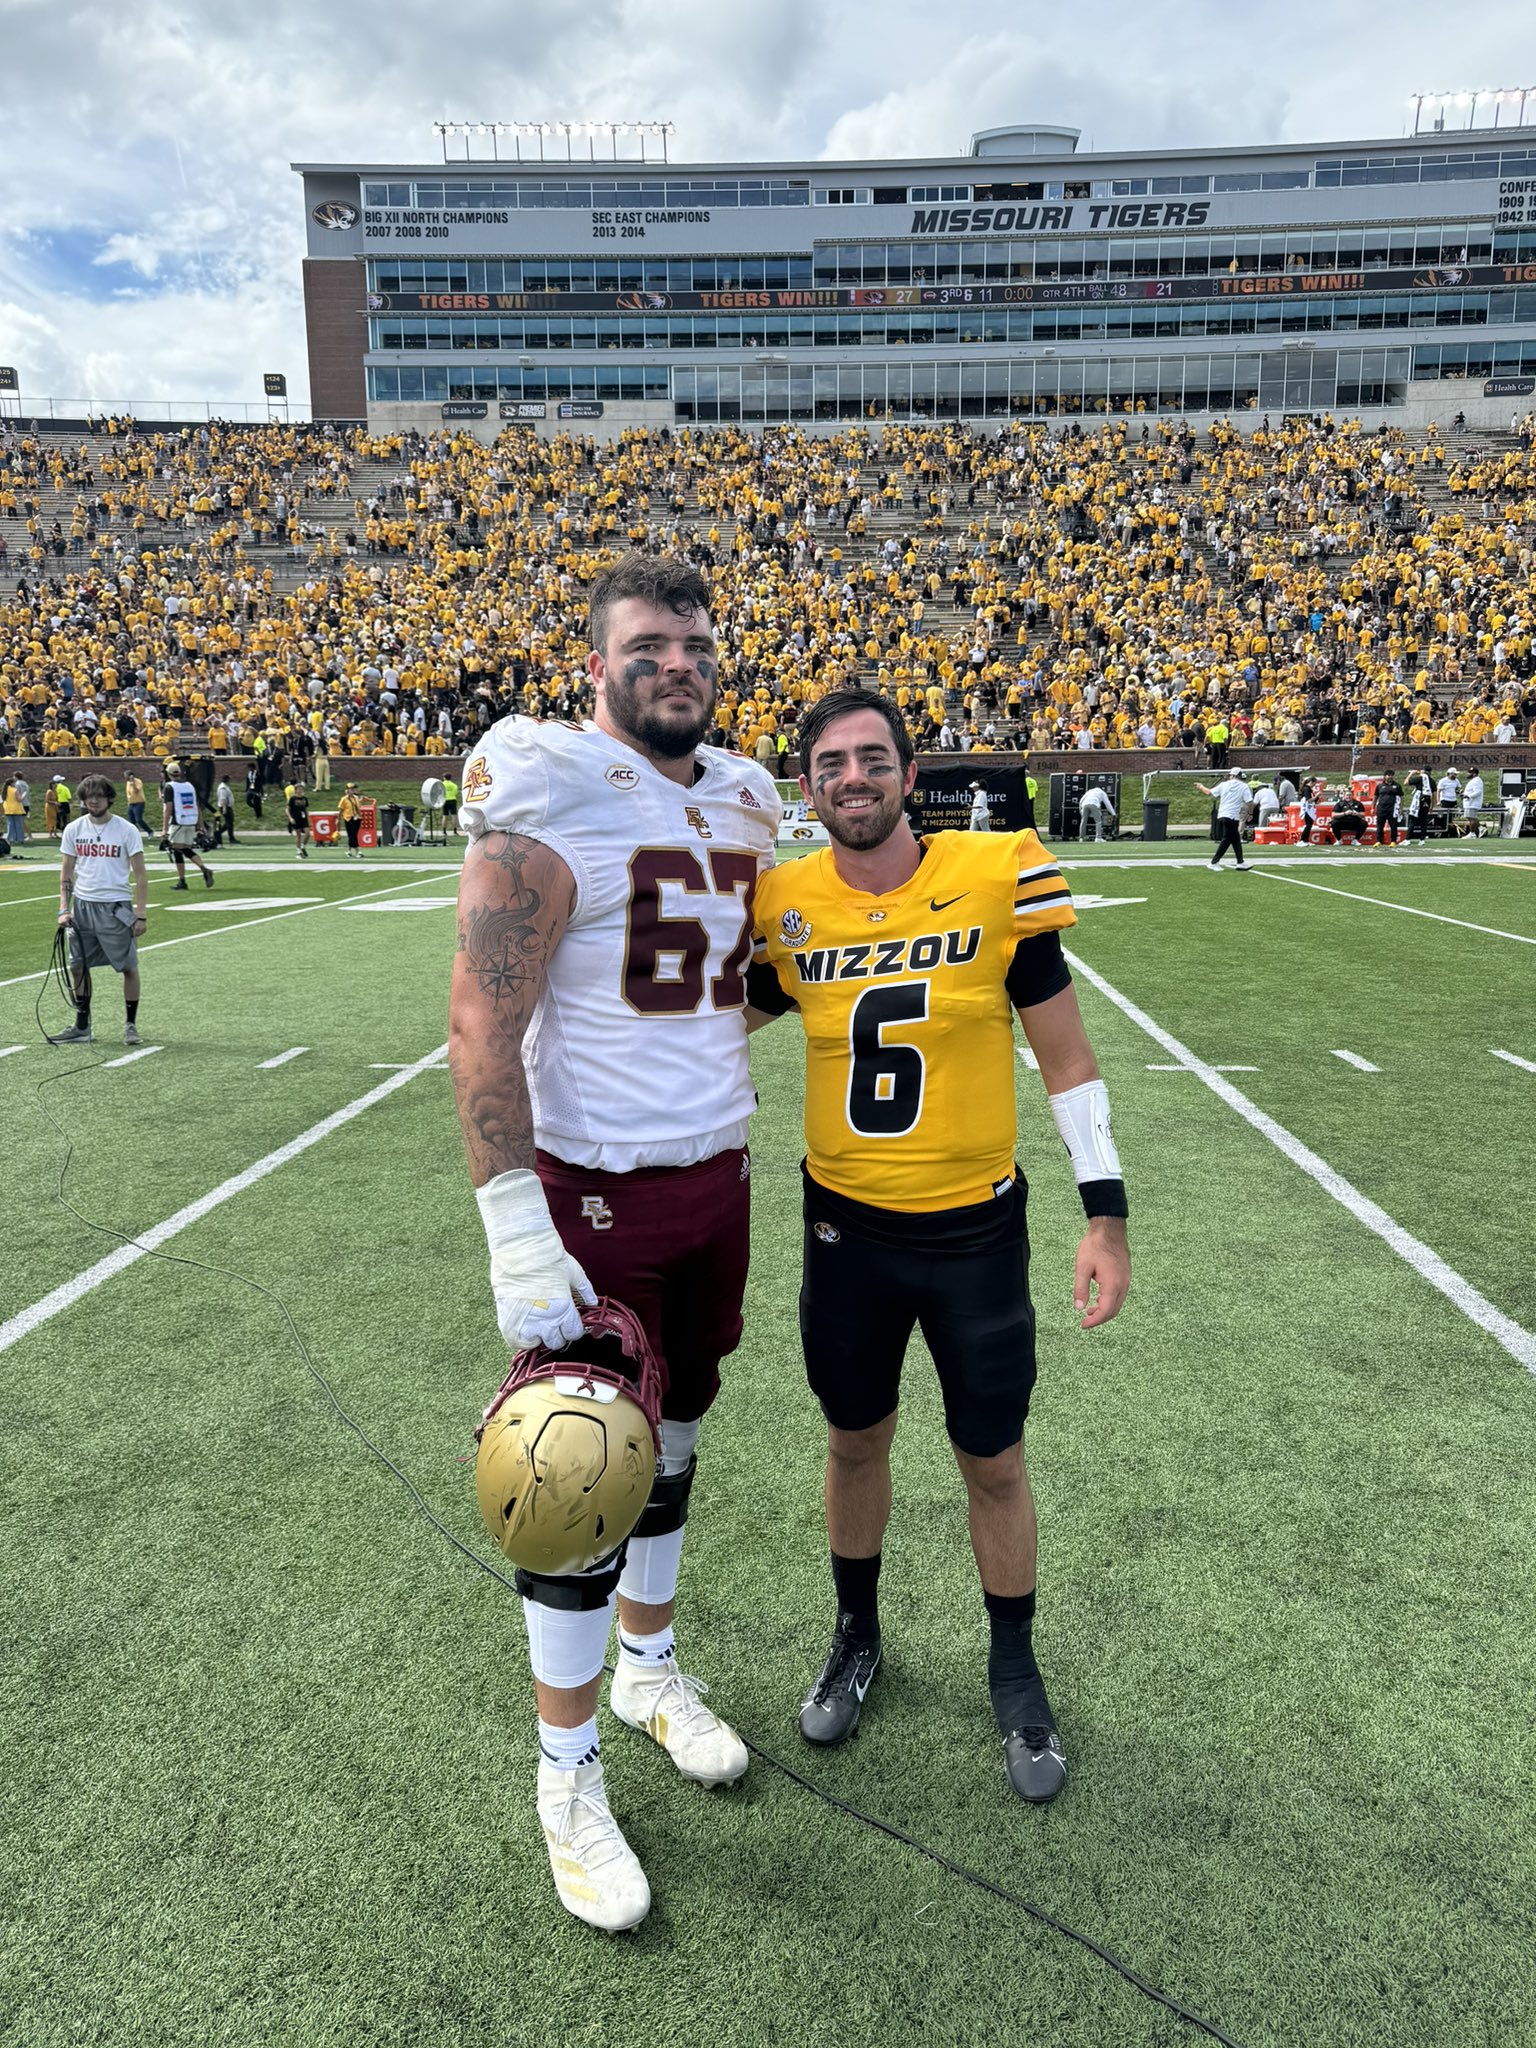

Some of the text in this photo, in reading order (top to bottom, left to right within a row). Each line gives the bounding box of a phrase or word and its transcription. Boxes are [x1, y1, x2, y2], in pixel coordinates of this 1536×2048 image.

[1499, 196, 1524, 208] 1909
[365, 212, 509, 224] BIG XII NORTH CHAMPIONS
[592, 211, 710, 223] SEC EAST CHAMPIONS
[911, 202, 1210, 233] MISSOURI TIGERS
[1498, 211, 1523, 223] 1942
[365, 226, 449, 238] 2007 2008 2010
[592, 226, 646, 238] 2013 2014
[1089, 284, 1108, 292] BALL
[1156, 282, 1172, 295] 21
[1222, 274, 1365, 293] TIGERS WIN!!!
[896, 290, 912, 303] 27
[979, 288, 992, 301] 11
[1004, 287, 1033, 300] 0:00
[1042, 287, 1086, 298] QTR 4TH
[1110, 285, 1127, 296] 48
[419, 295, 489, 309] TIGERS
[701, 291, 838, 308] TIGERS WIN!!!
[1373, 755, 1385, 764] 42
[1393, 755, 1440, 764] DAROLD
[1446, 754, 1499, 764] JENKINS
[610, 770, 634, 779] ACC
[929, 790, 1007, 803] Health are
[946, 809, 993, 817] PHYSICS
[316, 819, 330, 834] G
[362, 834, 372, 843] G
[783, 909, 802, 934] SEC
[620, 845, 759, 1016] 67
[784, 931, 809, 947] GRADUATE
[792, 925, 983, 984] MIZZOU
[846, 978, 930, 1138] 6
